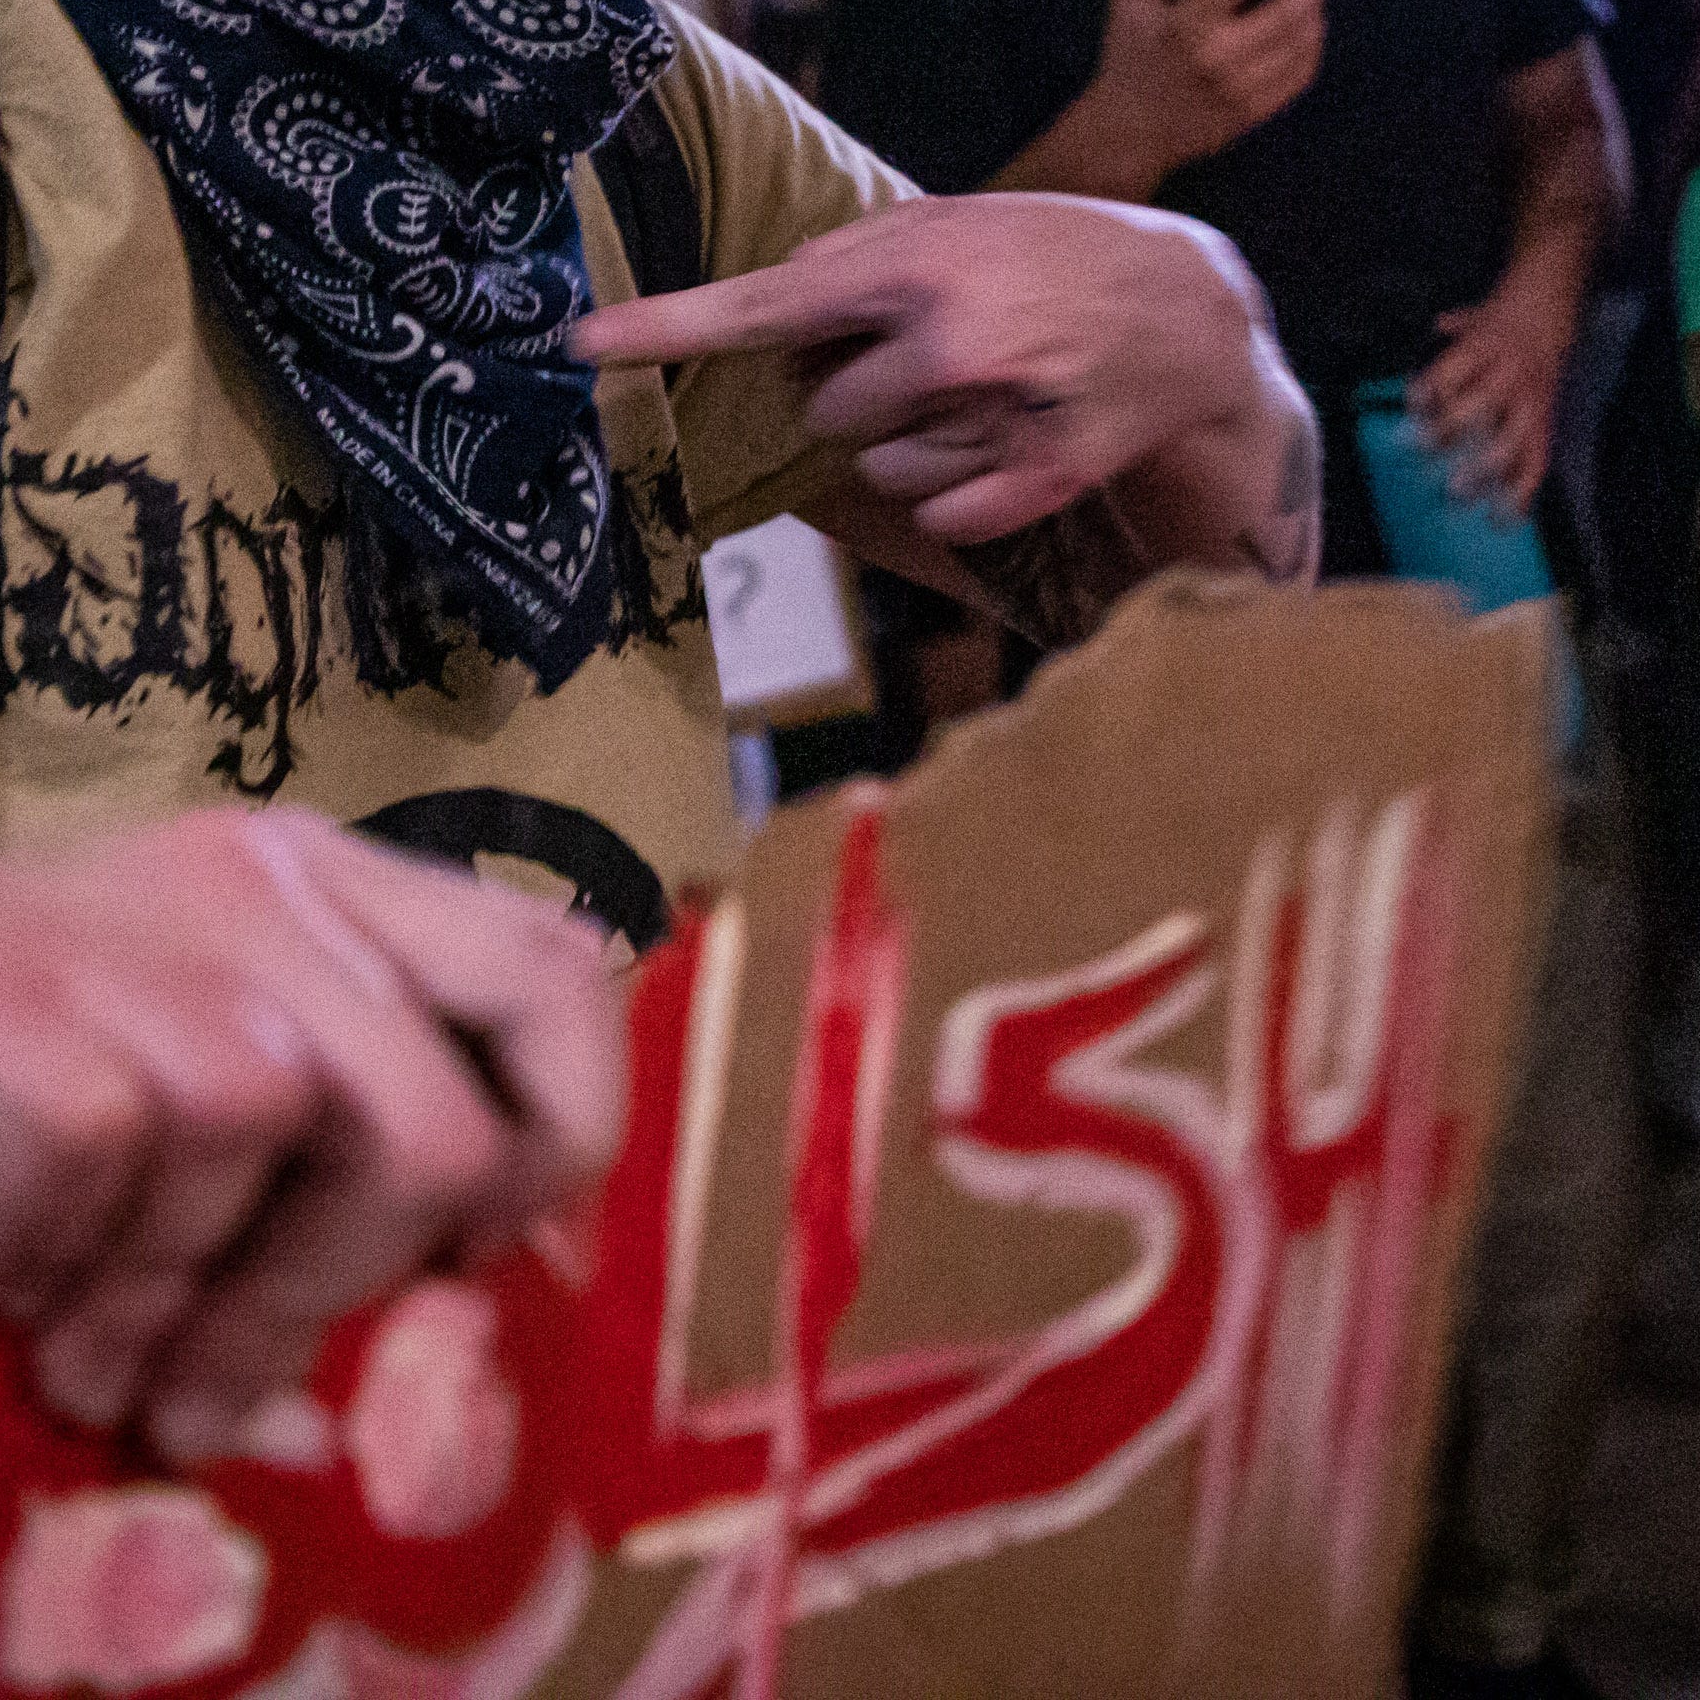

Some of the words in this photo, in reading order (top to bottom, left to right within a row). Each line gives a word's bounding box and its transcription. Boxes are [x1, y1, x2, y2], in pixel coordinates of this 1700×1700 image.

[316, 406, 376, 468] MADE
[371, 458, 399, 490] IN
[396, 482, 457, 547] CHINA
